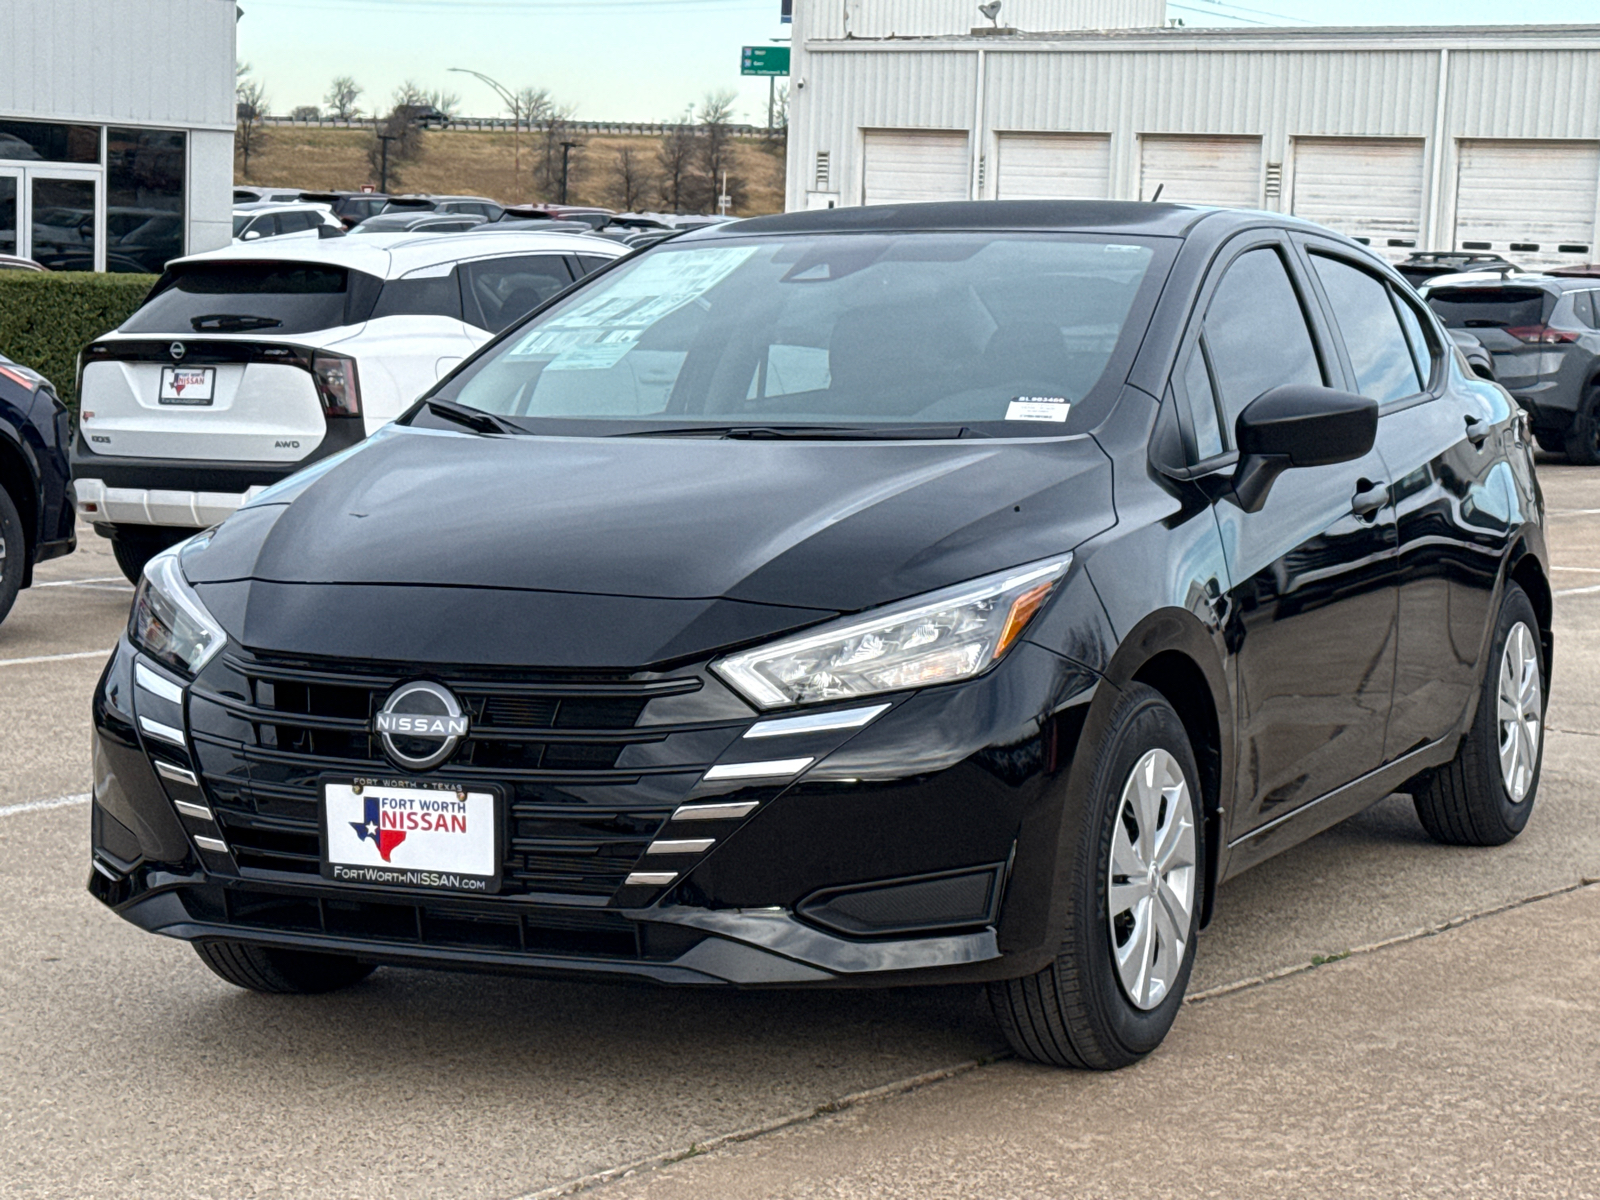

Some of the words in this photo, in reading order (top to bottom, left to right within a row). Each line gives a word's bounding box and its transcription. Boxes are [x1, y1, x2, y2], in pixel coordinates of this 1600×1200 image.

[179, 376, 205, 385] NISSAN
[275, 440, 300, 448] AWD
[377, 715, 464, 733] NISSAN
[353, 777, 378, 786] FORT
[382, 780, 417, 788] WORTH
[431, 783, 463, 792] TEXAS
[381, 797, 415, 810] FORT
[419, 799, 466, 813] WORTH
[381, 810, 467, 833] NISSAN
[1097, 793, 1115, 919] KUMHO
